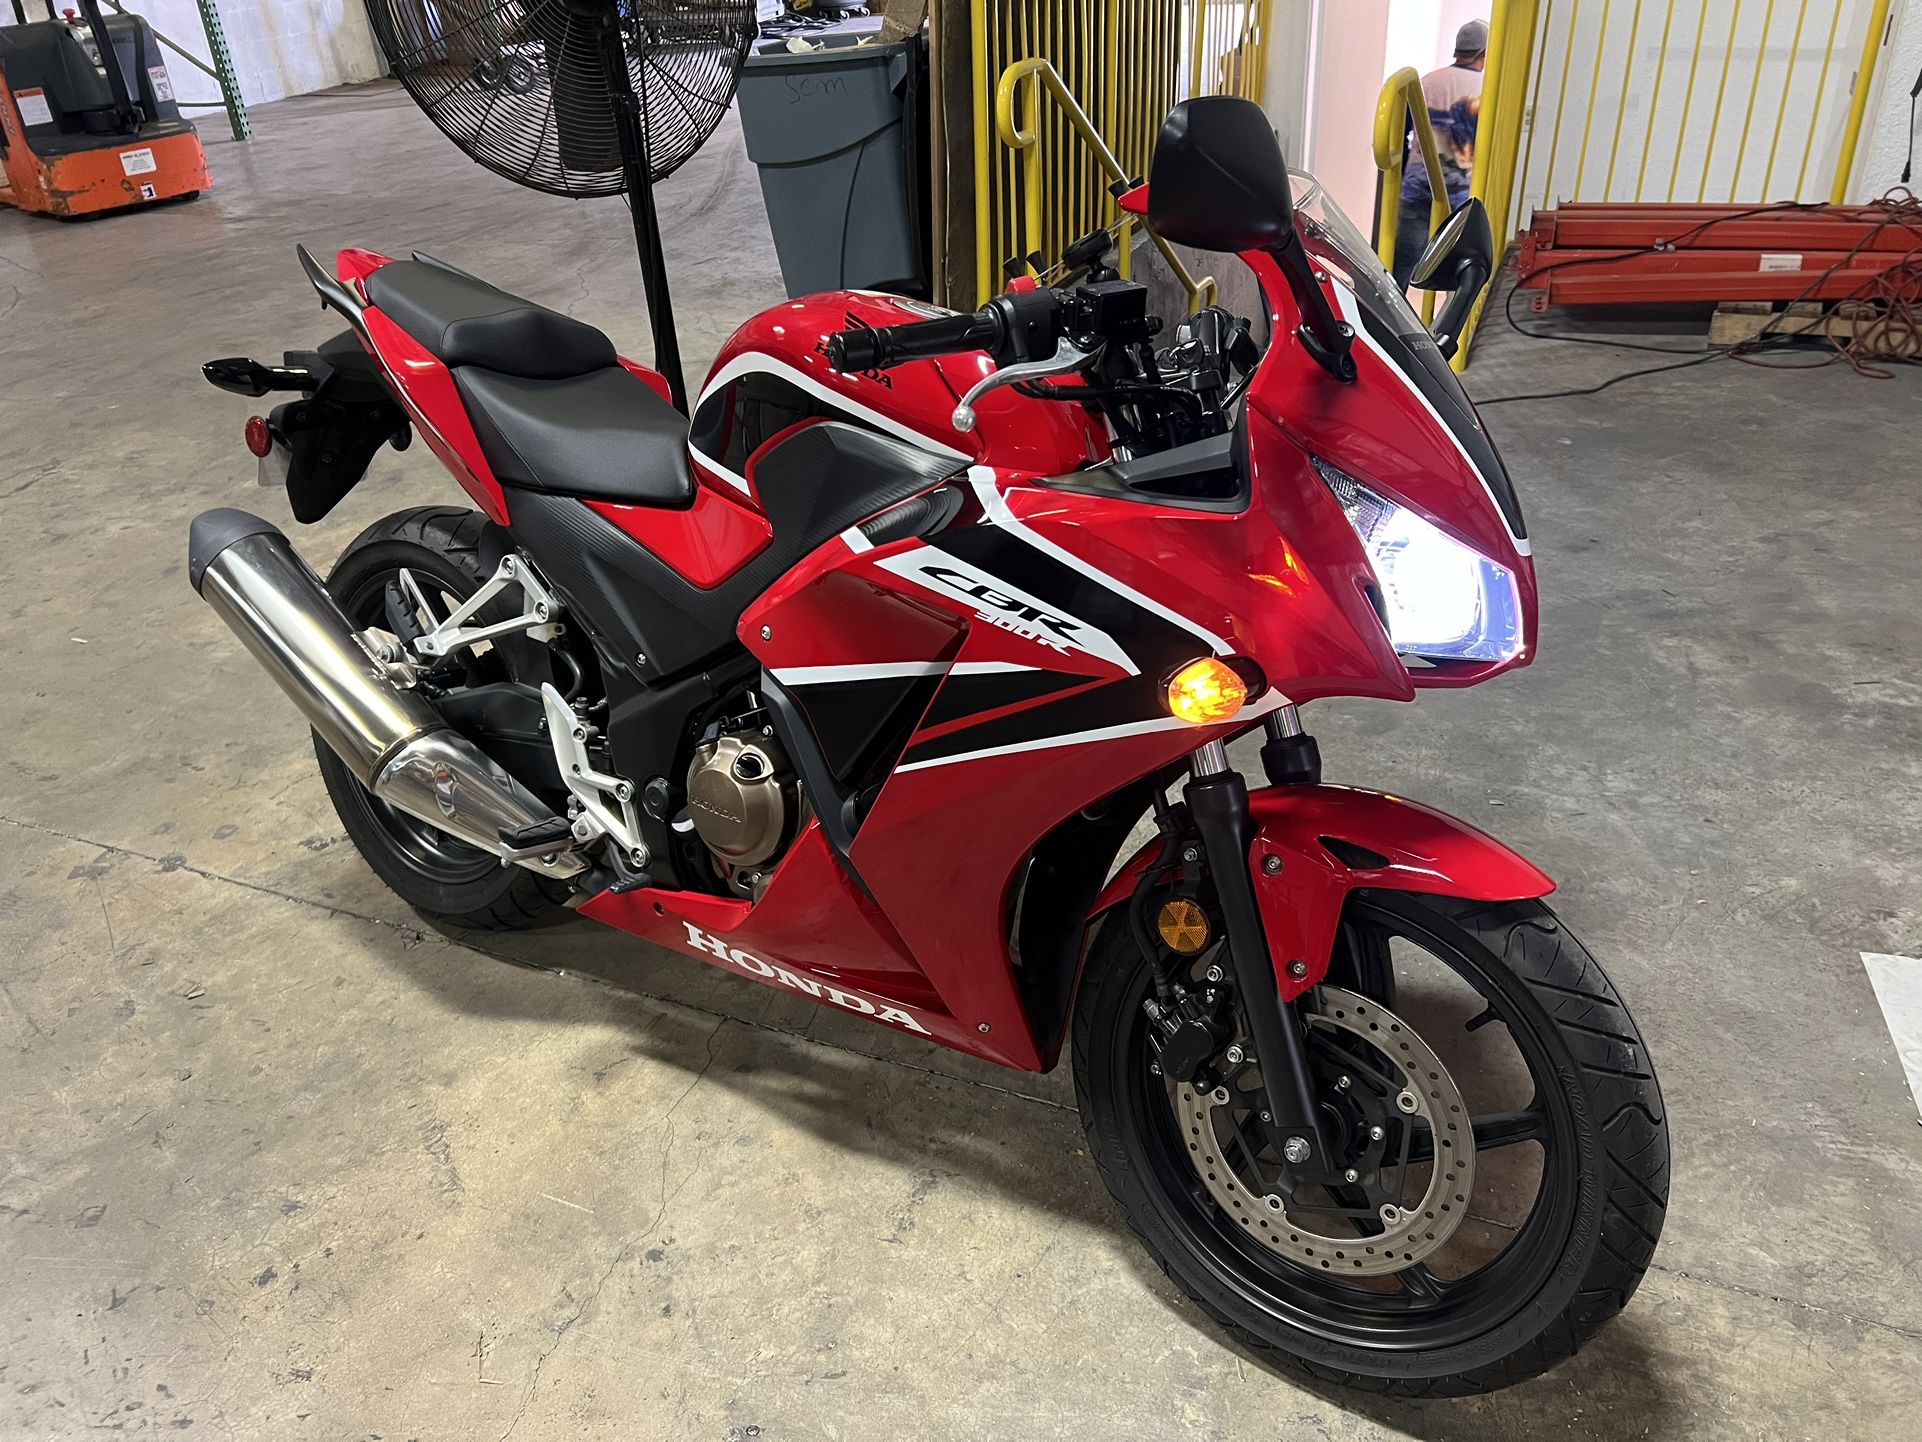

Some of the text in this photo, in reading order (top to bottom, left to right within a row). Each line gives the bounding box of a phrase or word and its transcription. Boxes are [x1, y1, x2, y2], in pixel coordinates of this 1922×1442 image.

[812, 341, 894, 390] HDA
[918, 566, 1085, 647] CBR
[974, 611, 1071, 657] 300R
[682, 920, 932, 1036] HONDA
